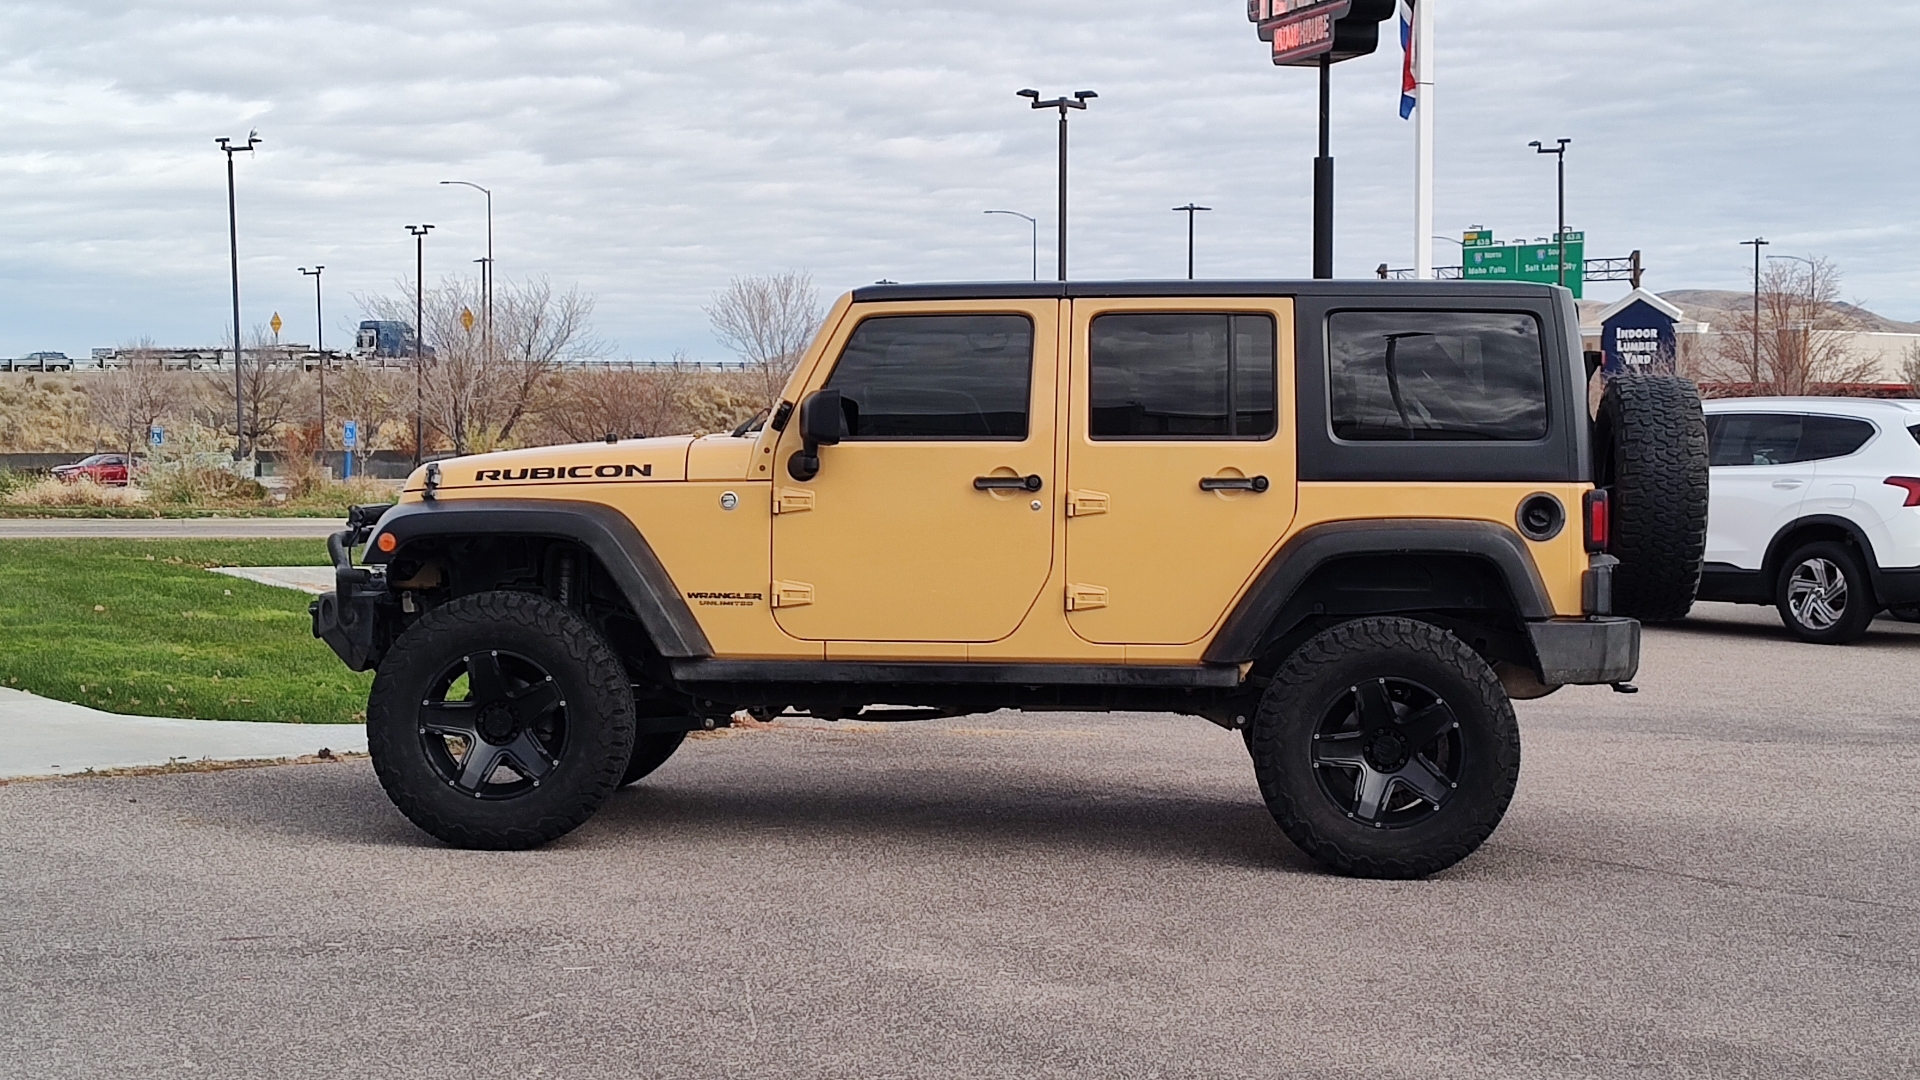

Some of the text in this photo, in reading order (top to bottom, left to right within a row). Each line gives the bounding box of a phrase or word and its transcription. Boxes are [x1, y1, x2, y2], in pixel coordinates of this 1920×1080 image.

[1274, 14, 1330, 52] ROADHOUSE
[1468, 266, 1507, 275] Idaho Falls
[1524, 264, 1540, 272] Salt
[1616, 327, 1658, 339] INDOOR
[1616, 340, 1658, 352] LUMBER
[1622, 353, 1652, 365] YARD
[475, 464, 652, 481] RUBICON
[687, 592, 763, 600] WRANGLER
